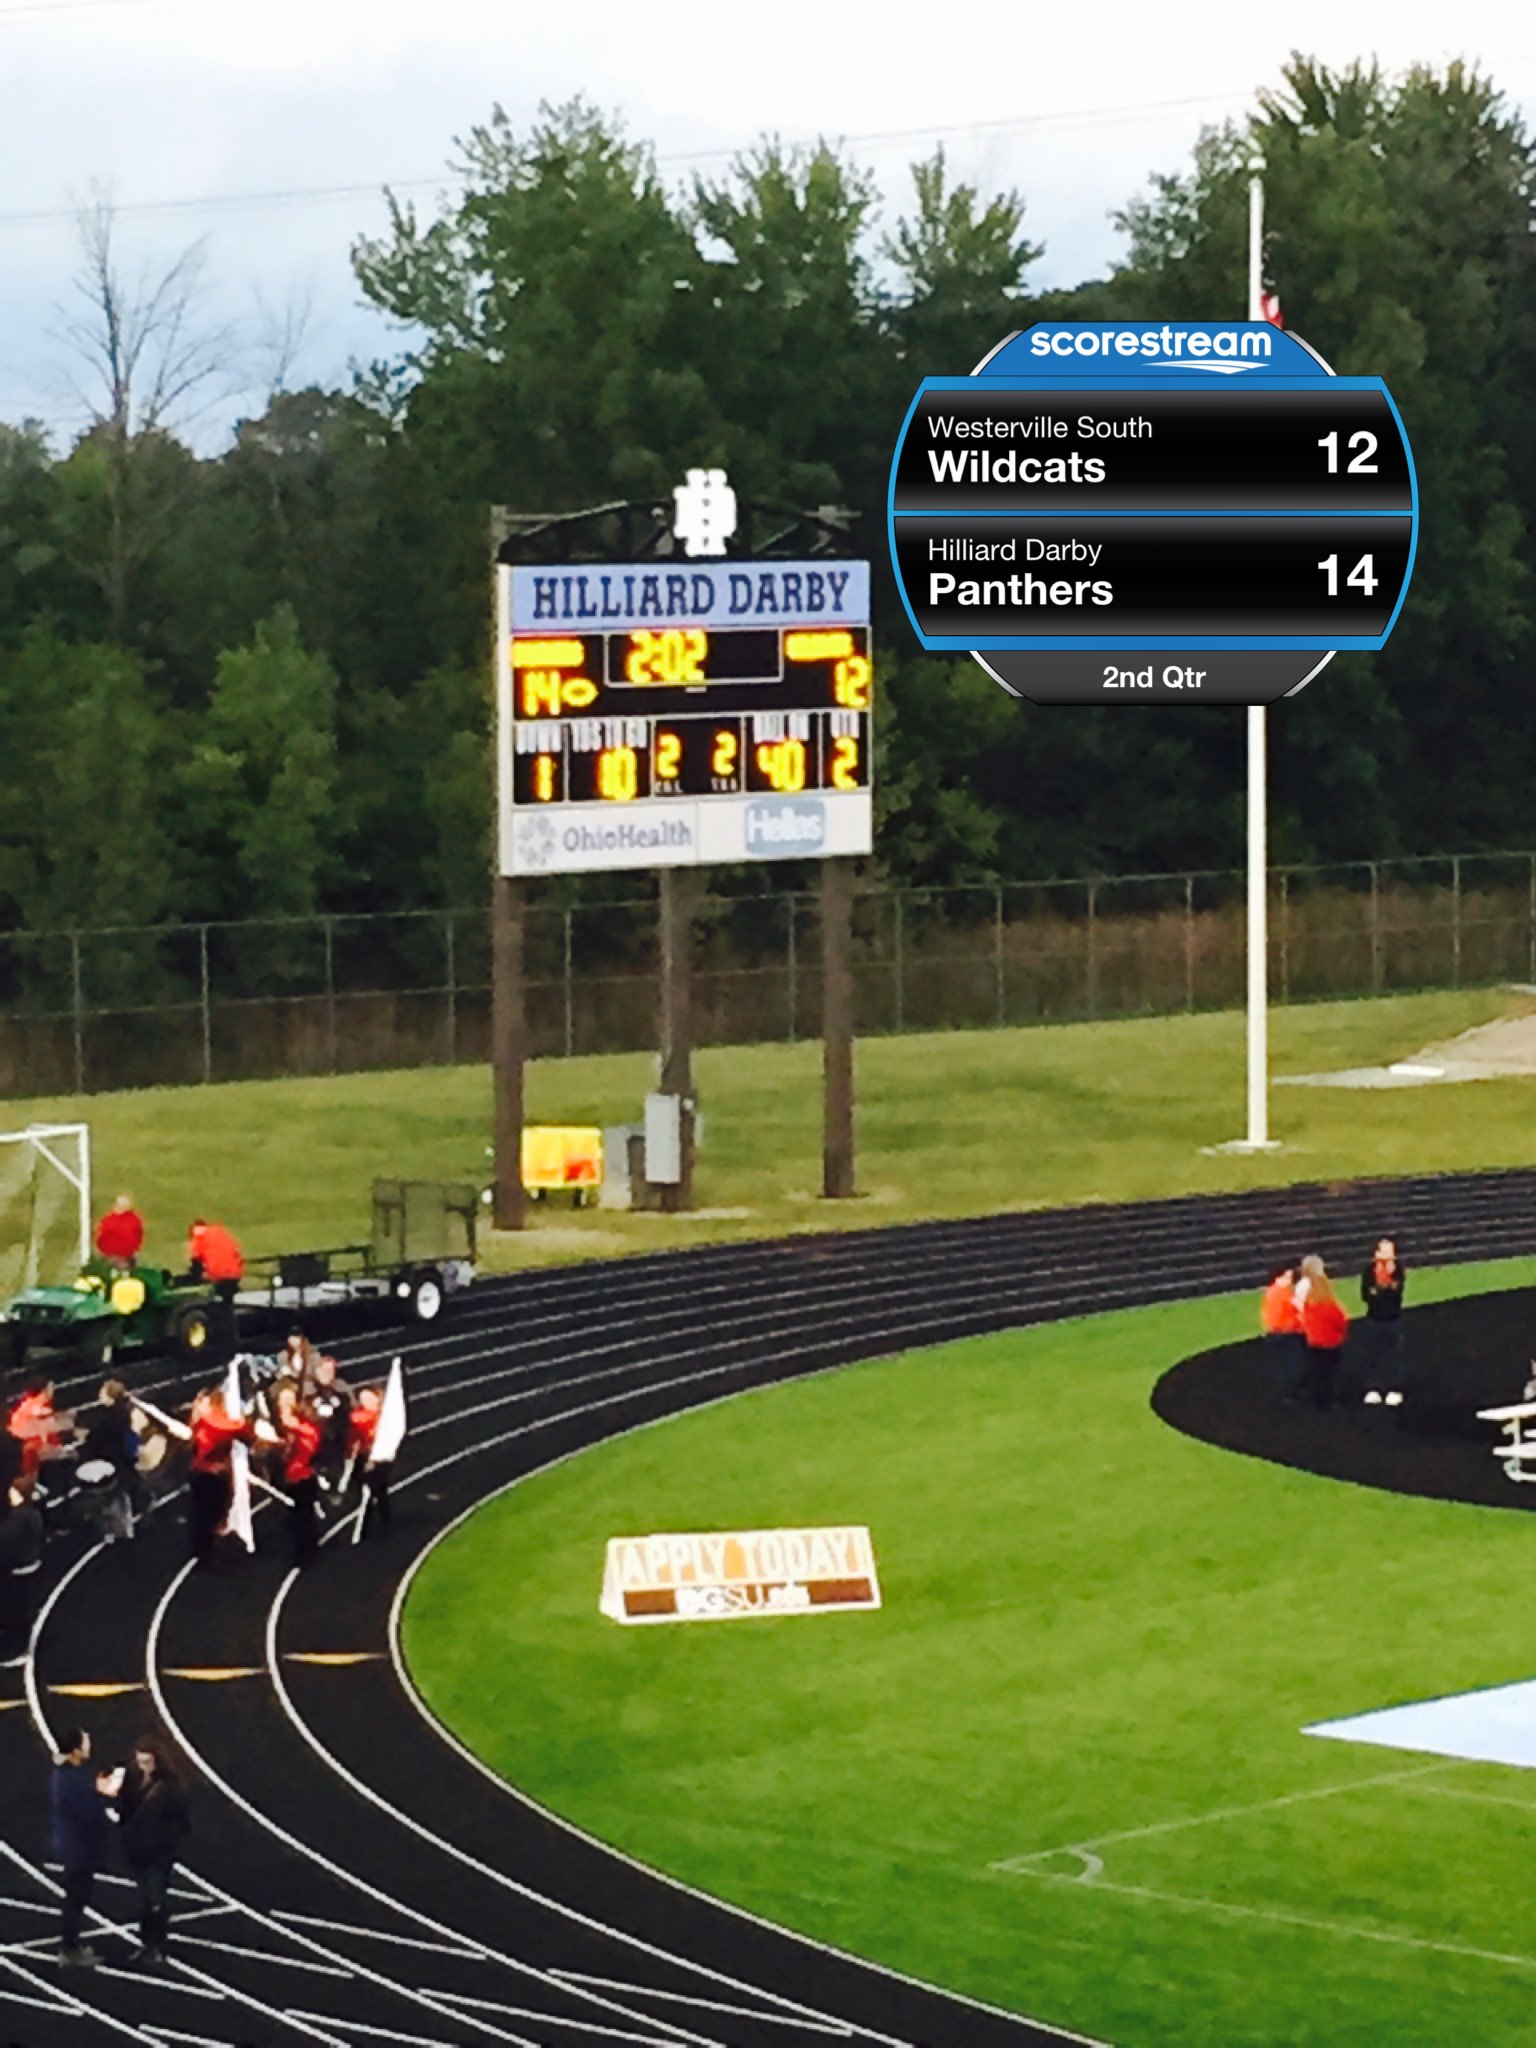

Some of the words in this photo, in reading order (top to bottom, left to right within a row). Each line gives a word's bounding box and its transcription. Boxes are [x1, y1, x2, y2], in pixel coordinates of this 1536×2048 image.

[533, 573, 715, 619] HILLIARD
[729, 571, 849, 613] DARBY
[627, 629, 708, 684] 2:02
[522, 670, 561, 716] 14
[834, 656, 870, 708] 12
[600, 747, 638, 801] 10
[657, 733, 682, 779] 2
[713, 730, 737, 776] 2
[757, 739, 806, 792] 40
[833, 737, 859, 791] 2
[563, 819, 692, 852] OhioHealth
[622, 1538, 726, 1586] APPLY
